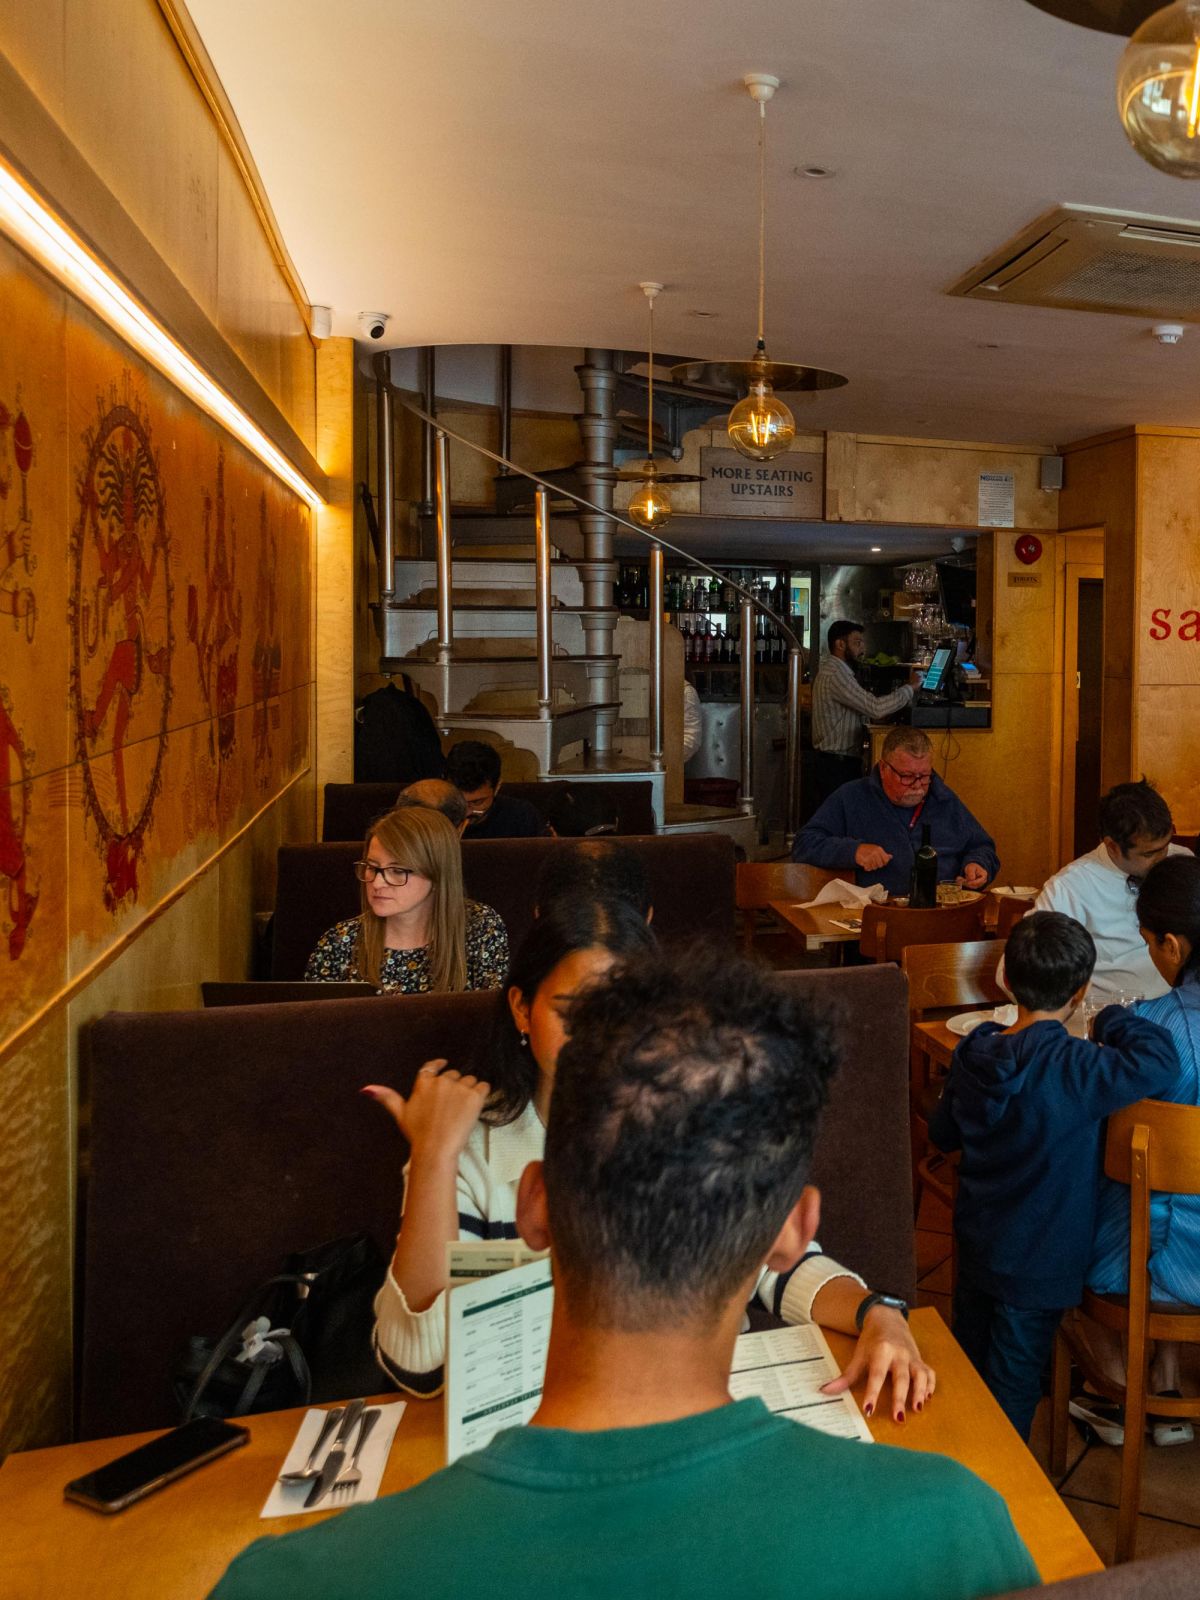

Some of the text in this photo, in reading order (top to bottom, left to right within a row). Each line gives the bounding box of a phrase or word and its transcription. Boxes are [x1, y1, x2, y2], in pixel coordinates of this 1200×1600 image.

[711, 467, 813, 483] MORE SEATING
[731, 483, 794, 497] UPSTAIRS
